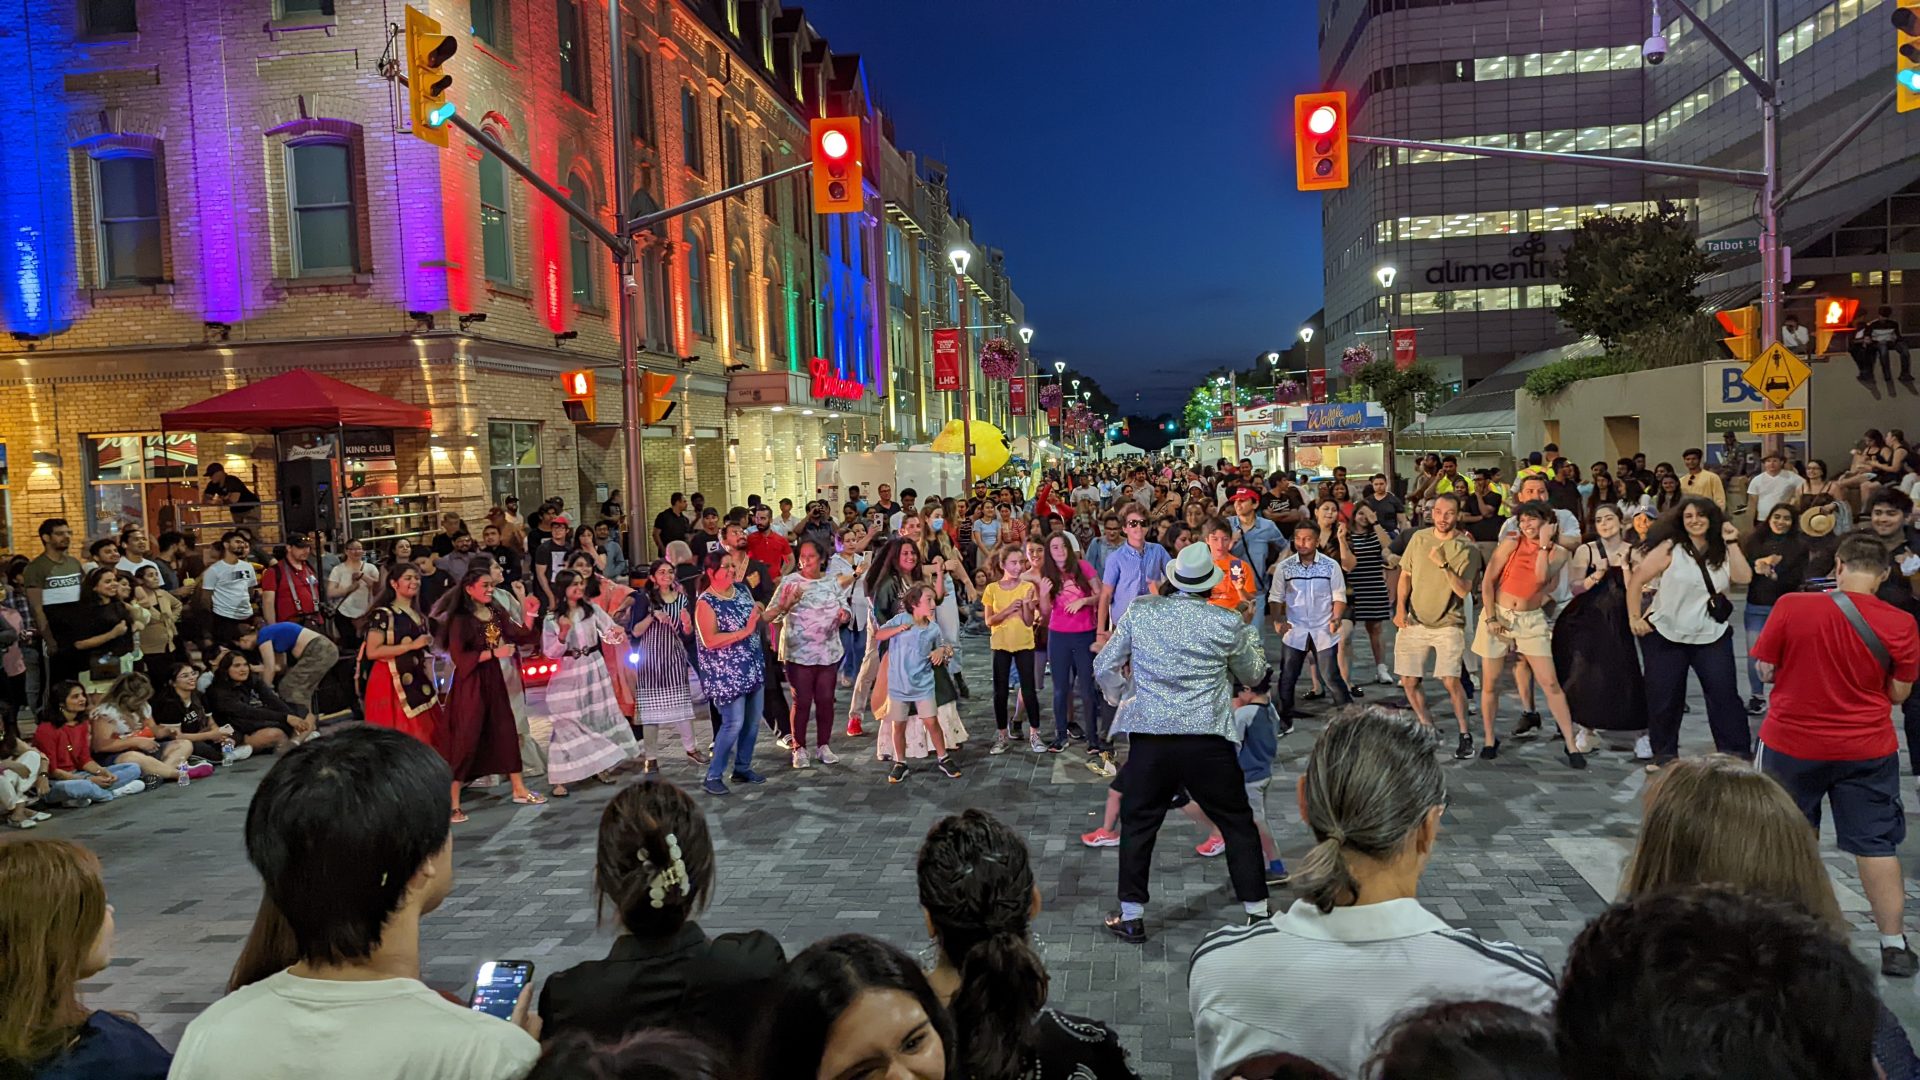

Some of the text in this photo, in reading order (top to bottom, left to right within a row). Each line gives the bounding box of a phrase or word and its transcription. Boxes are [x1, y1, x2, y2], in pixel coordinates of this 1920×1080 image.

[1707, 240, 1743, 251] Talbot
[1425, 255, 1559, 284] alimenti
[939, 376, 956, 385] LHC
[1762, 413, 1792, 421] SHARE
[1714, 417, 1750, 428] Servic
[1774, 420, 1800, 428] ROAD
[345, 444, 391, 454] KING CLUB
